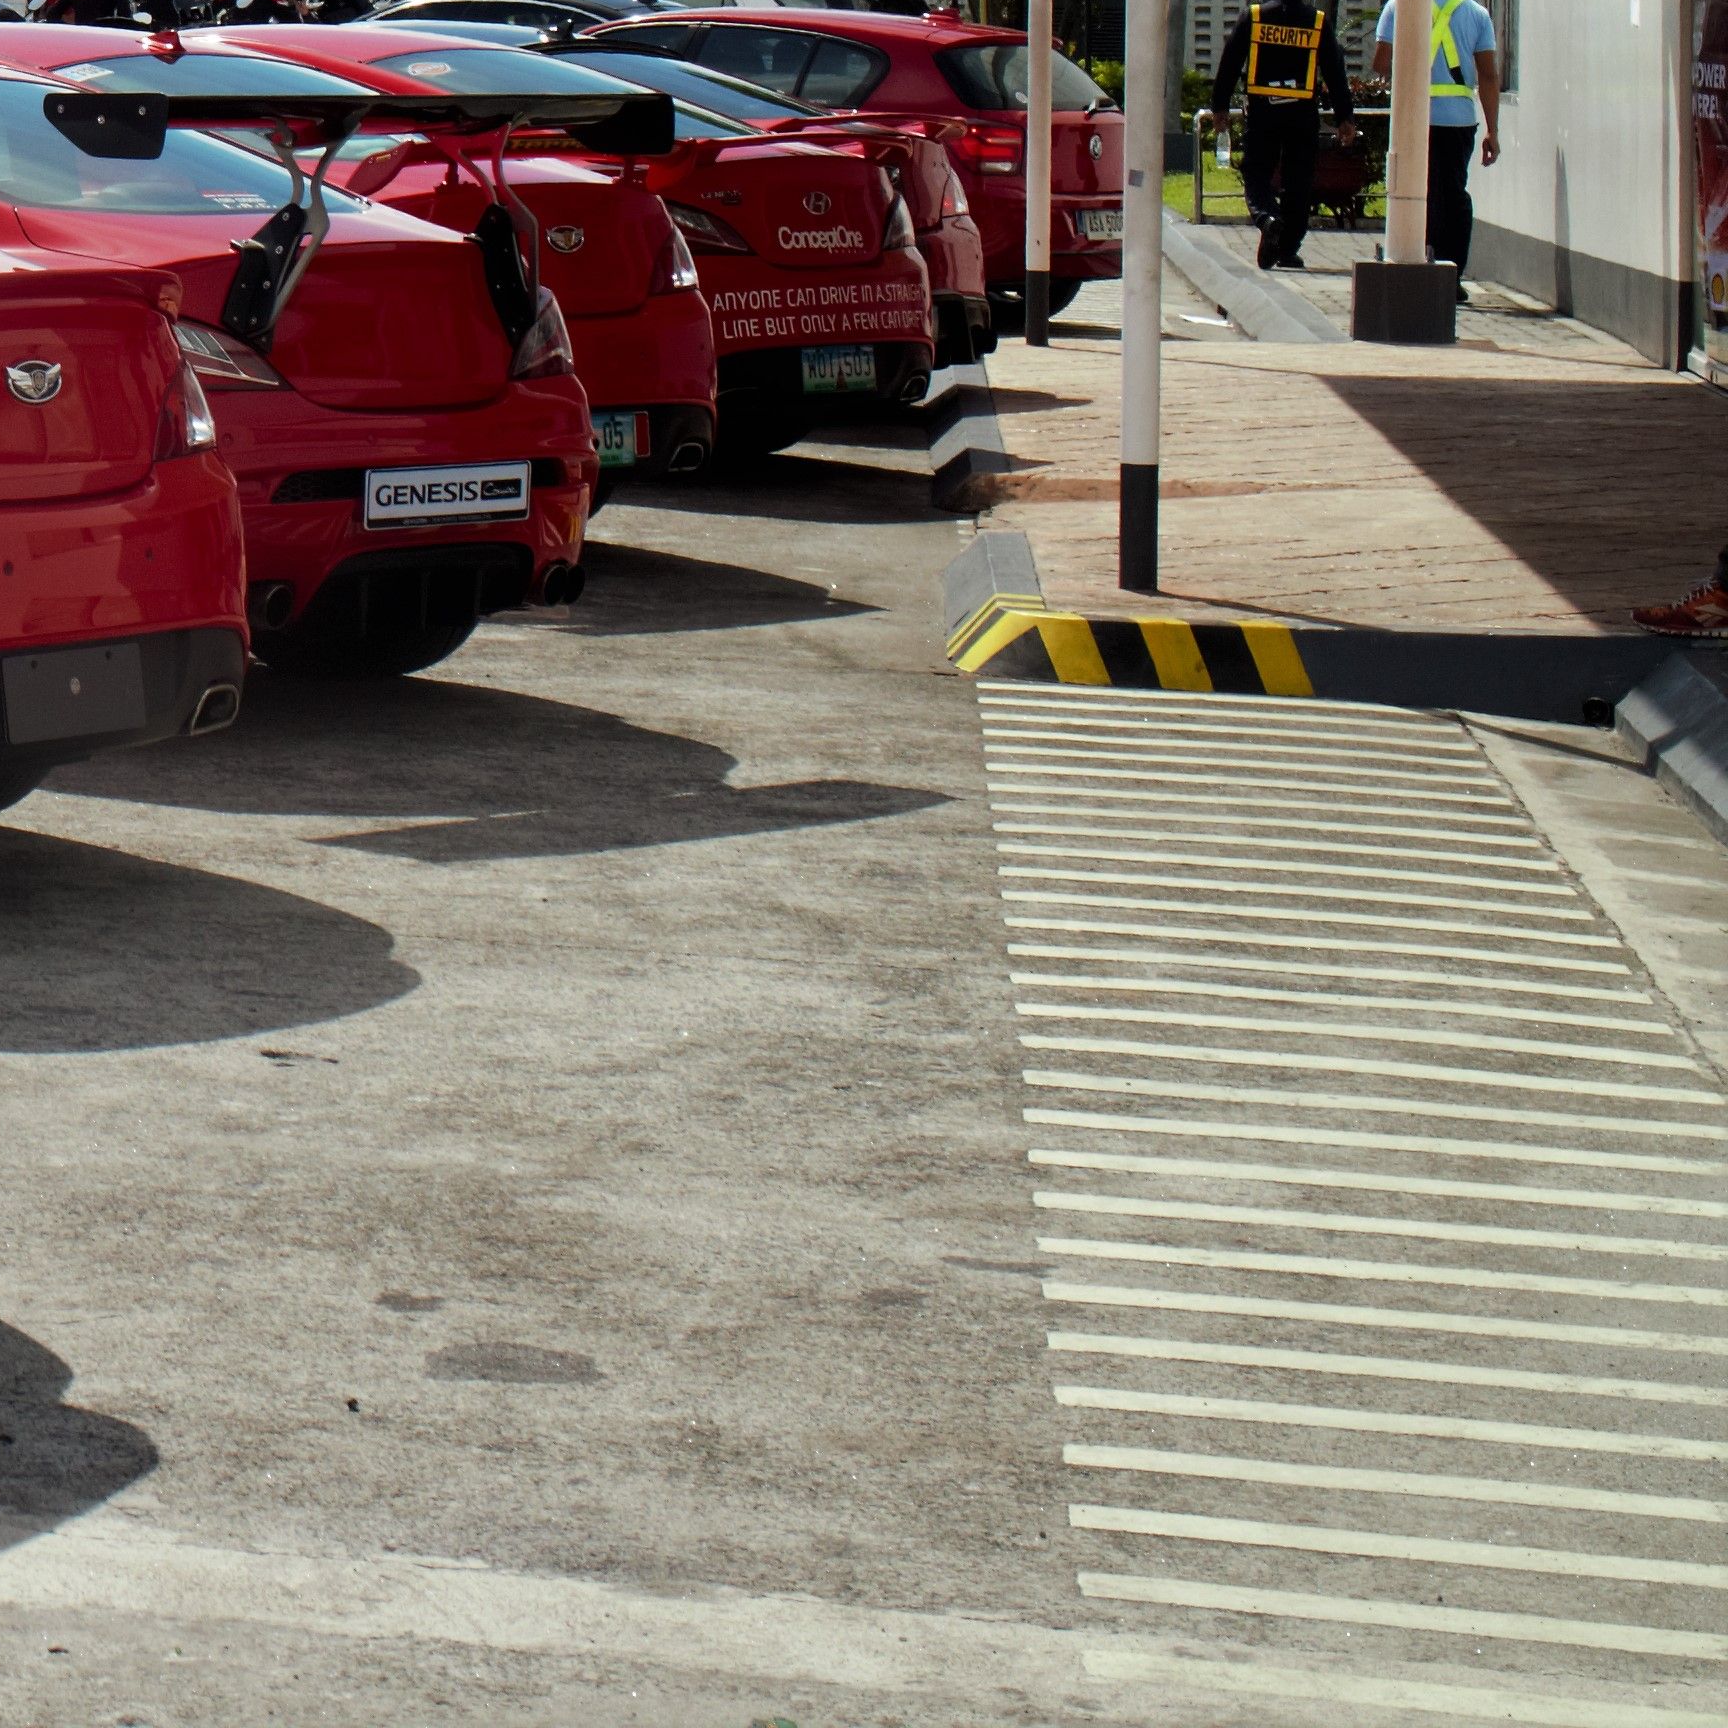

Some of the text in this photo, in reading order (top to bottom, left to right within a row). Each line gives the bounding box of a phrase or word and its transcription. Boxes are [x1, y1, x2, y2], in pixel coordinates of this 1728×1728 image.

[1259, 24, 1313, 47] SECURITY
[1693, 62, 1727, 91] OWER
[777, 225, 864, 253] ConceptOne
[713, 288, 783, 312] ANYONE
[786, 286, 816, 308] CAN
[820, 284, 859, 305] DRIVE
[862, 284, 874, 303] IN
[722, 318, 762, 339] LINE
[765, 315, 796, 337] BUT
[800, 313, 837, 334] ONLY
[842, 312, 851, 331] A
[853, 311, 880, 330] FEW
[880, 310, 903, 330] CAN
[375, 480, 479, 507] GENESIS
